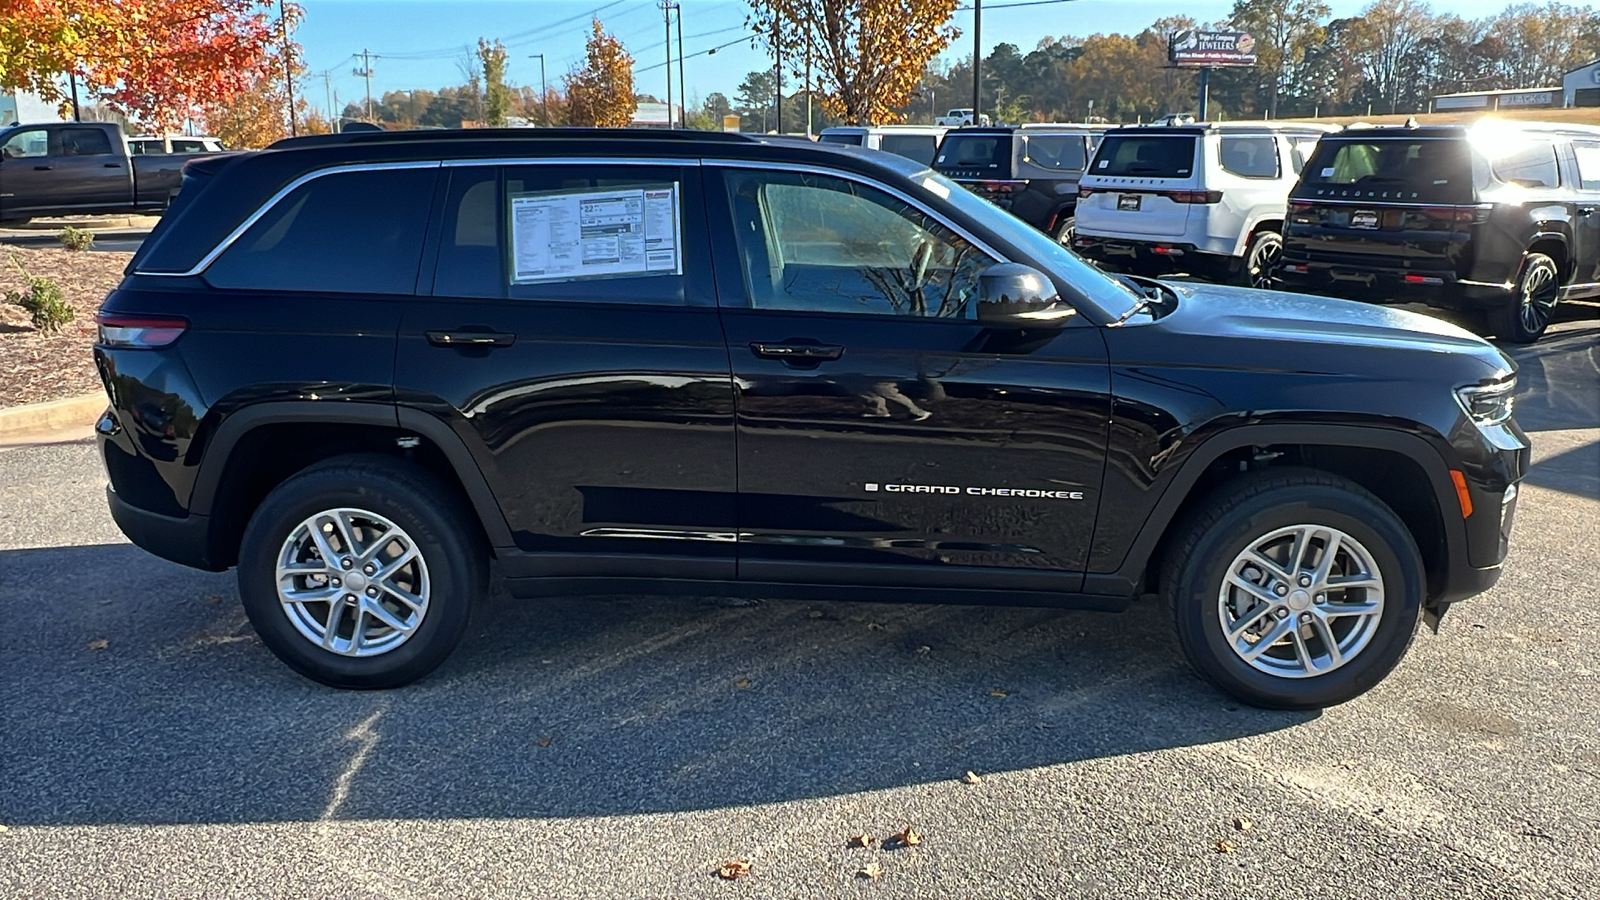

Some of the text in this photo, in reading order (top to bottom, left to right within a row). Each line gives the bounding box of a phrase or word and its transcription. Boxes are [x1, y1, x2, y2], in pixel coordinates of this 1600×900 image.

[1199, 41, 1234, 50] JEWELERS
[1317, 189, 1419, 199] WAGONEER
[885, 483, 1084, 501] GRAND CHEROKEE
